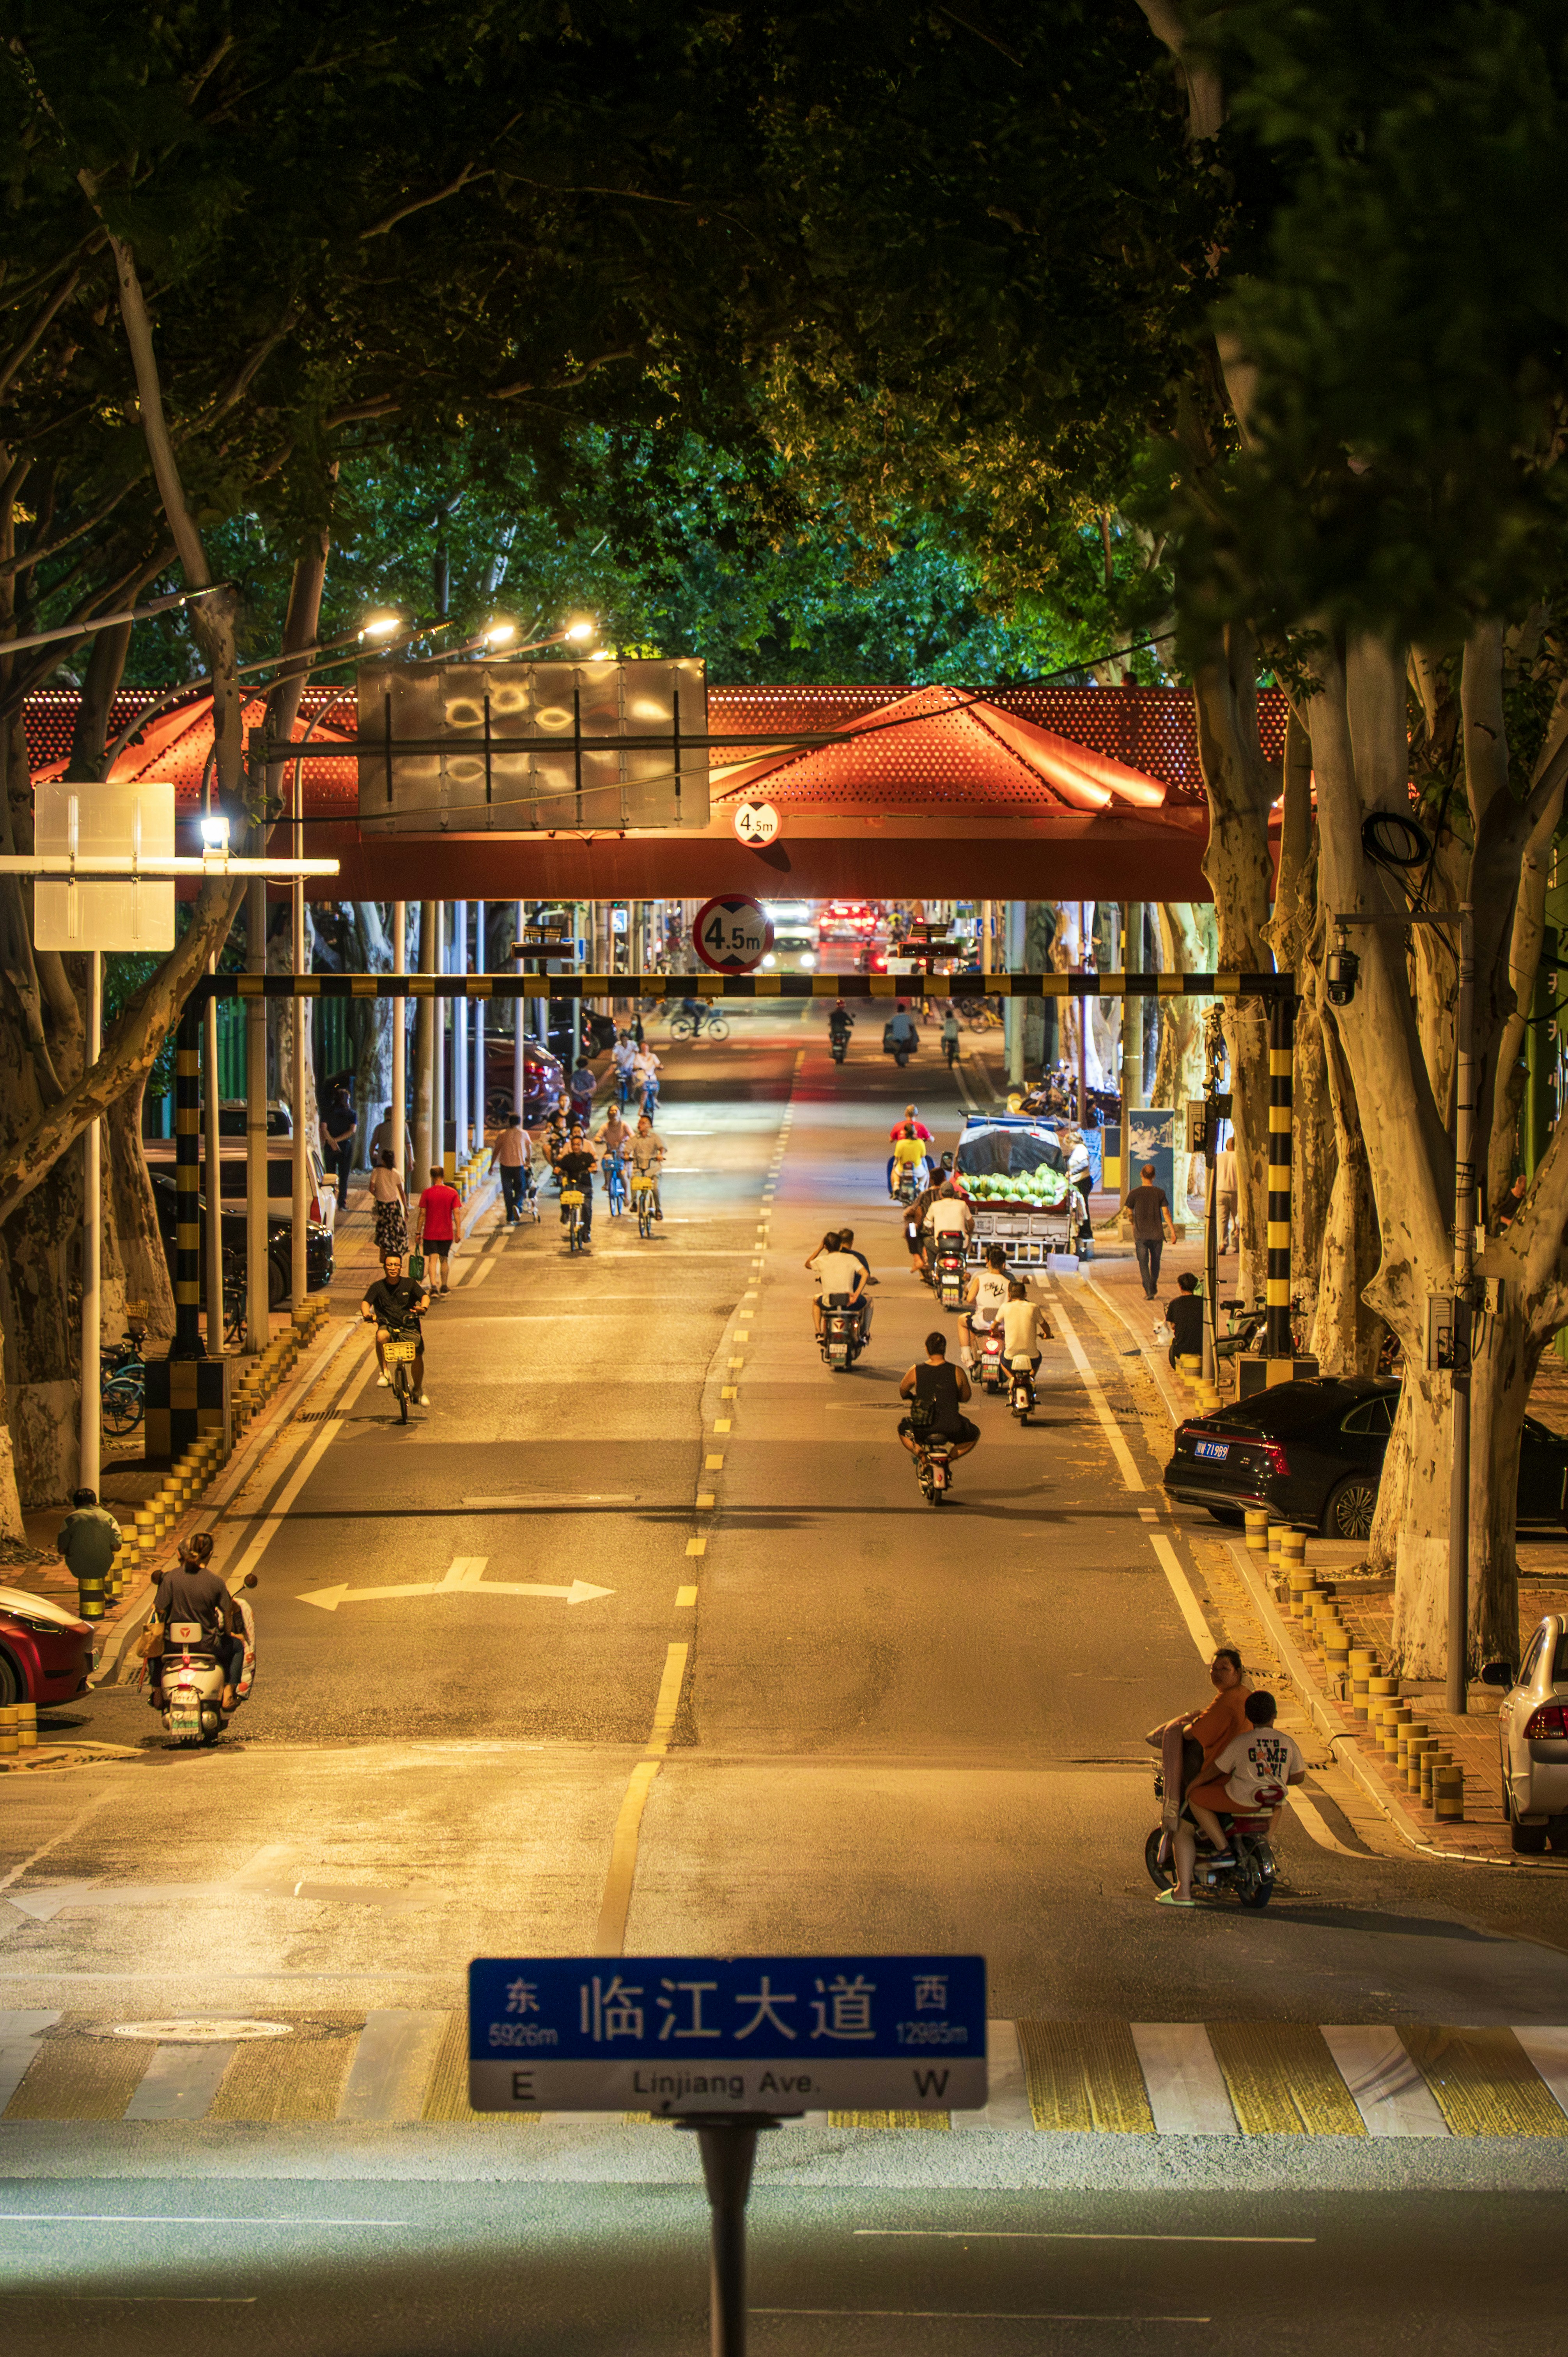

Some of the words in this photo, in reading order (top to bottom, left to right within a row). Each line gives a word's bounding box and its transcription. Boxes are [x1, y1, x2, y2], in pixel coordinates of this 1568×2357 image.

[740, 814, 773, 831] 4.5m
[705, 917, 760, 950] 4.5m
[1248, 1747, 1288, 1763] GME
[1256, 1739, 1279, 1747] IT'S
[1256, 1763, 1282, 1777] DY!
[507, 1976, 540, 2013] 东
[580, 1974, 877, 2042] 临江大道
[912, 1975, 949, 2011] 西
[488, 2023, 559, 2047] 5926m
[512, 2070, 536, 2100] E
[633, 2070, 744, 2100] Linjiang
[759, 2070, 821, 2093] Ave.
[912, 2068, 950, 2098] W
